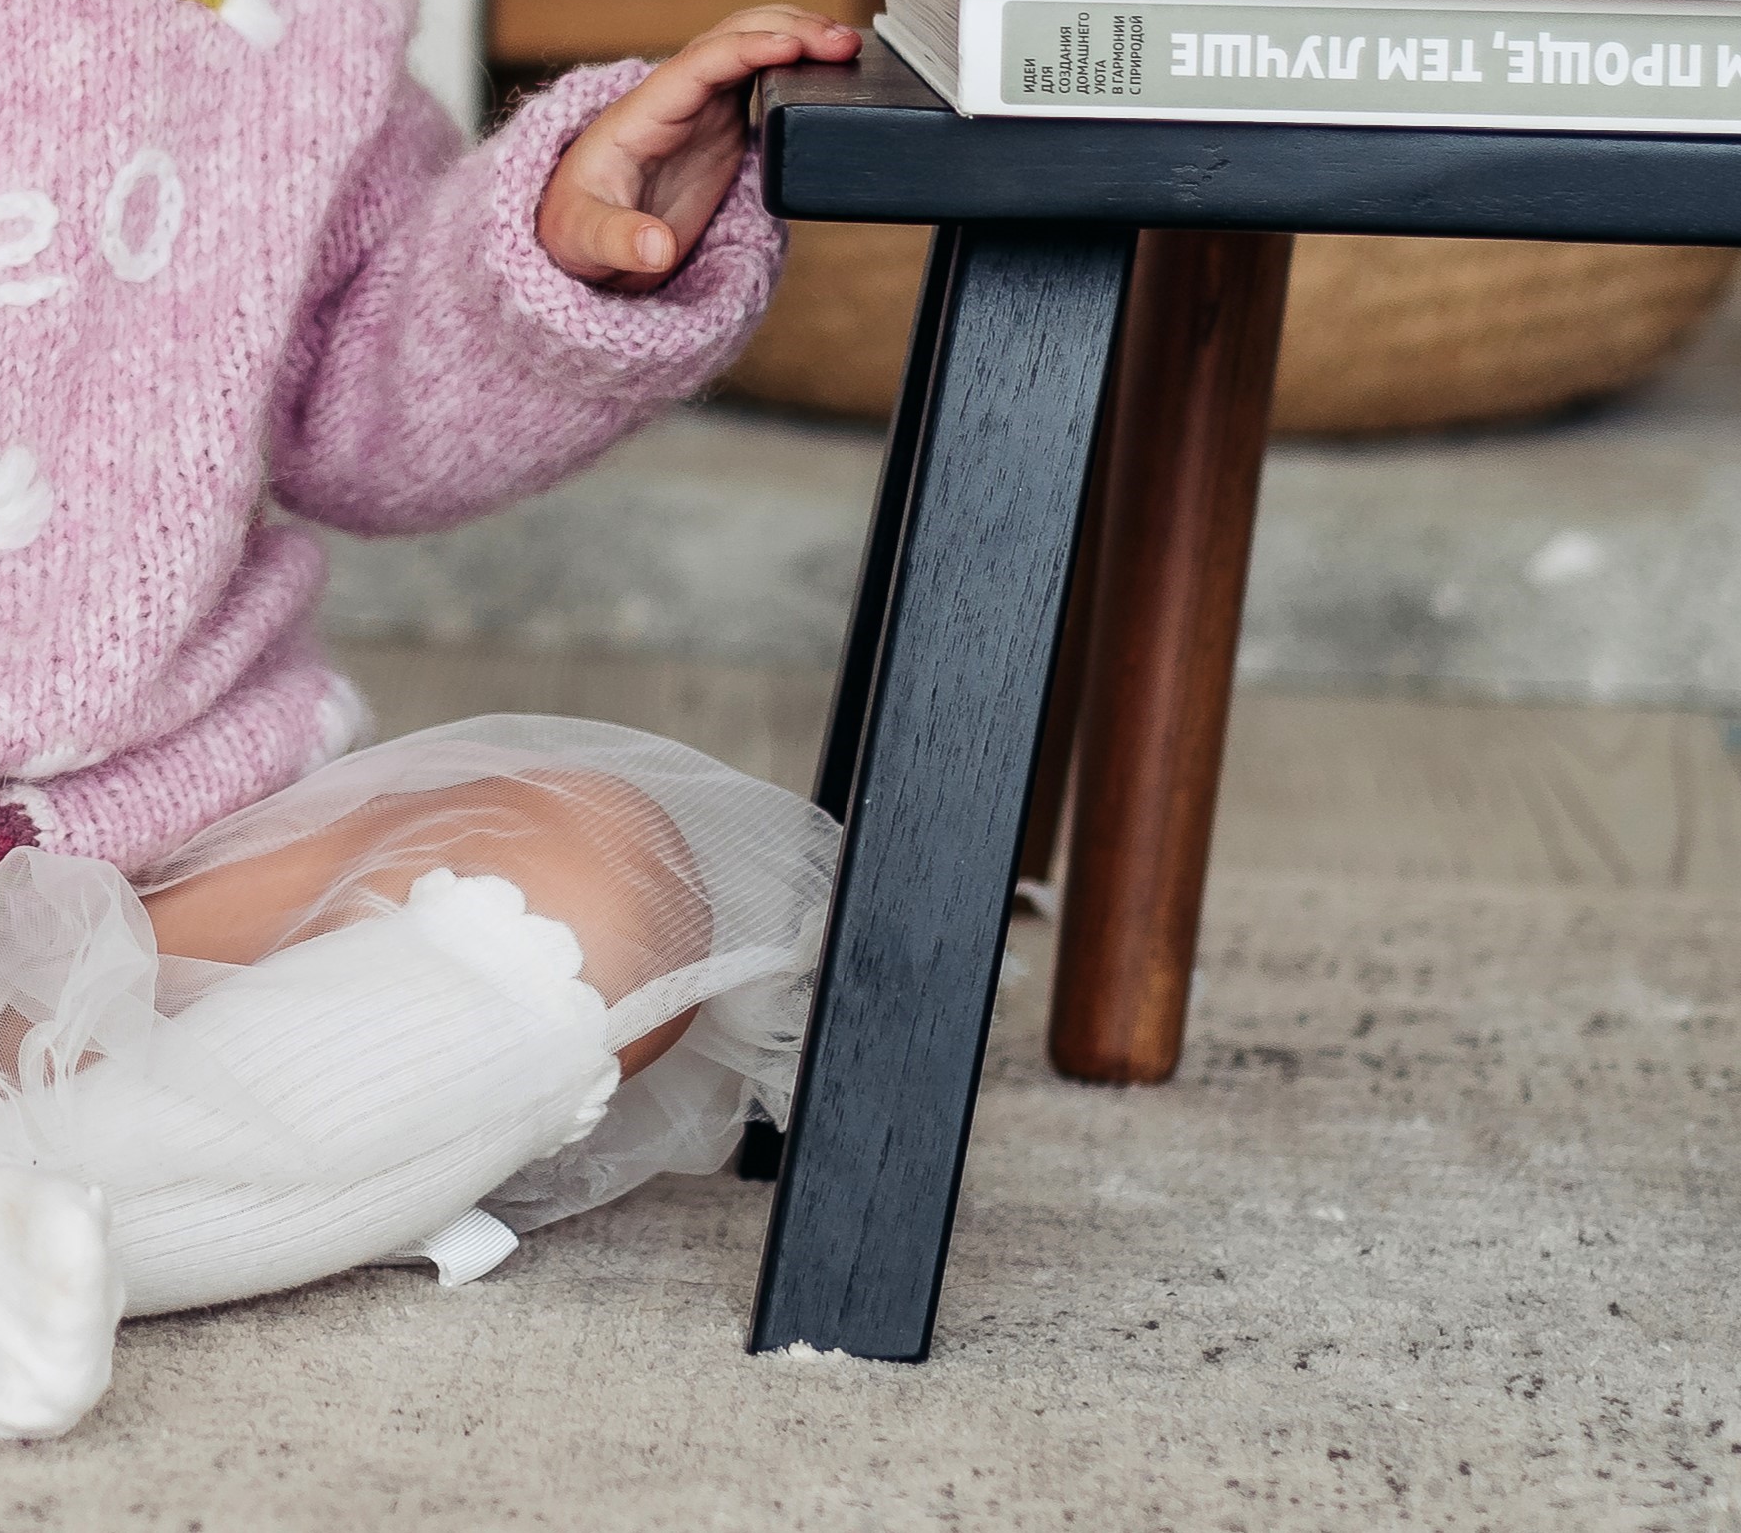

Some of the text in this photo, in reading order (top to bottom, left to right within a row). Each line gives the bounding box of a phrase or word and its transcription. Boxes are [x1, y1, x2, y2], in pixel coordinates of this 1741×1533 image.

[1023, 58, 1038, 93] ИДЕИ
[1059, 26, 1073, 94] СОЗДАНИЯ
[1076, 12, 1090, 95] ДОМАШНЕГО
[1094, 59, 1107, 94] УЮТА
[1112, 15, 1125, 95] В ГАРМОНИИ
[1129, 15, 1145, 95] С ПРИРОДОЙ
[1170, 33, 1366, 80] ЛУЧШЕ
[1378, 37, 1483, 82] ТЕМ
[1492, 31, 1702, 87] ПРОЩЕ,
[1041, 66, 1055, 94] ДЛЯ
